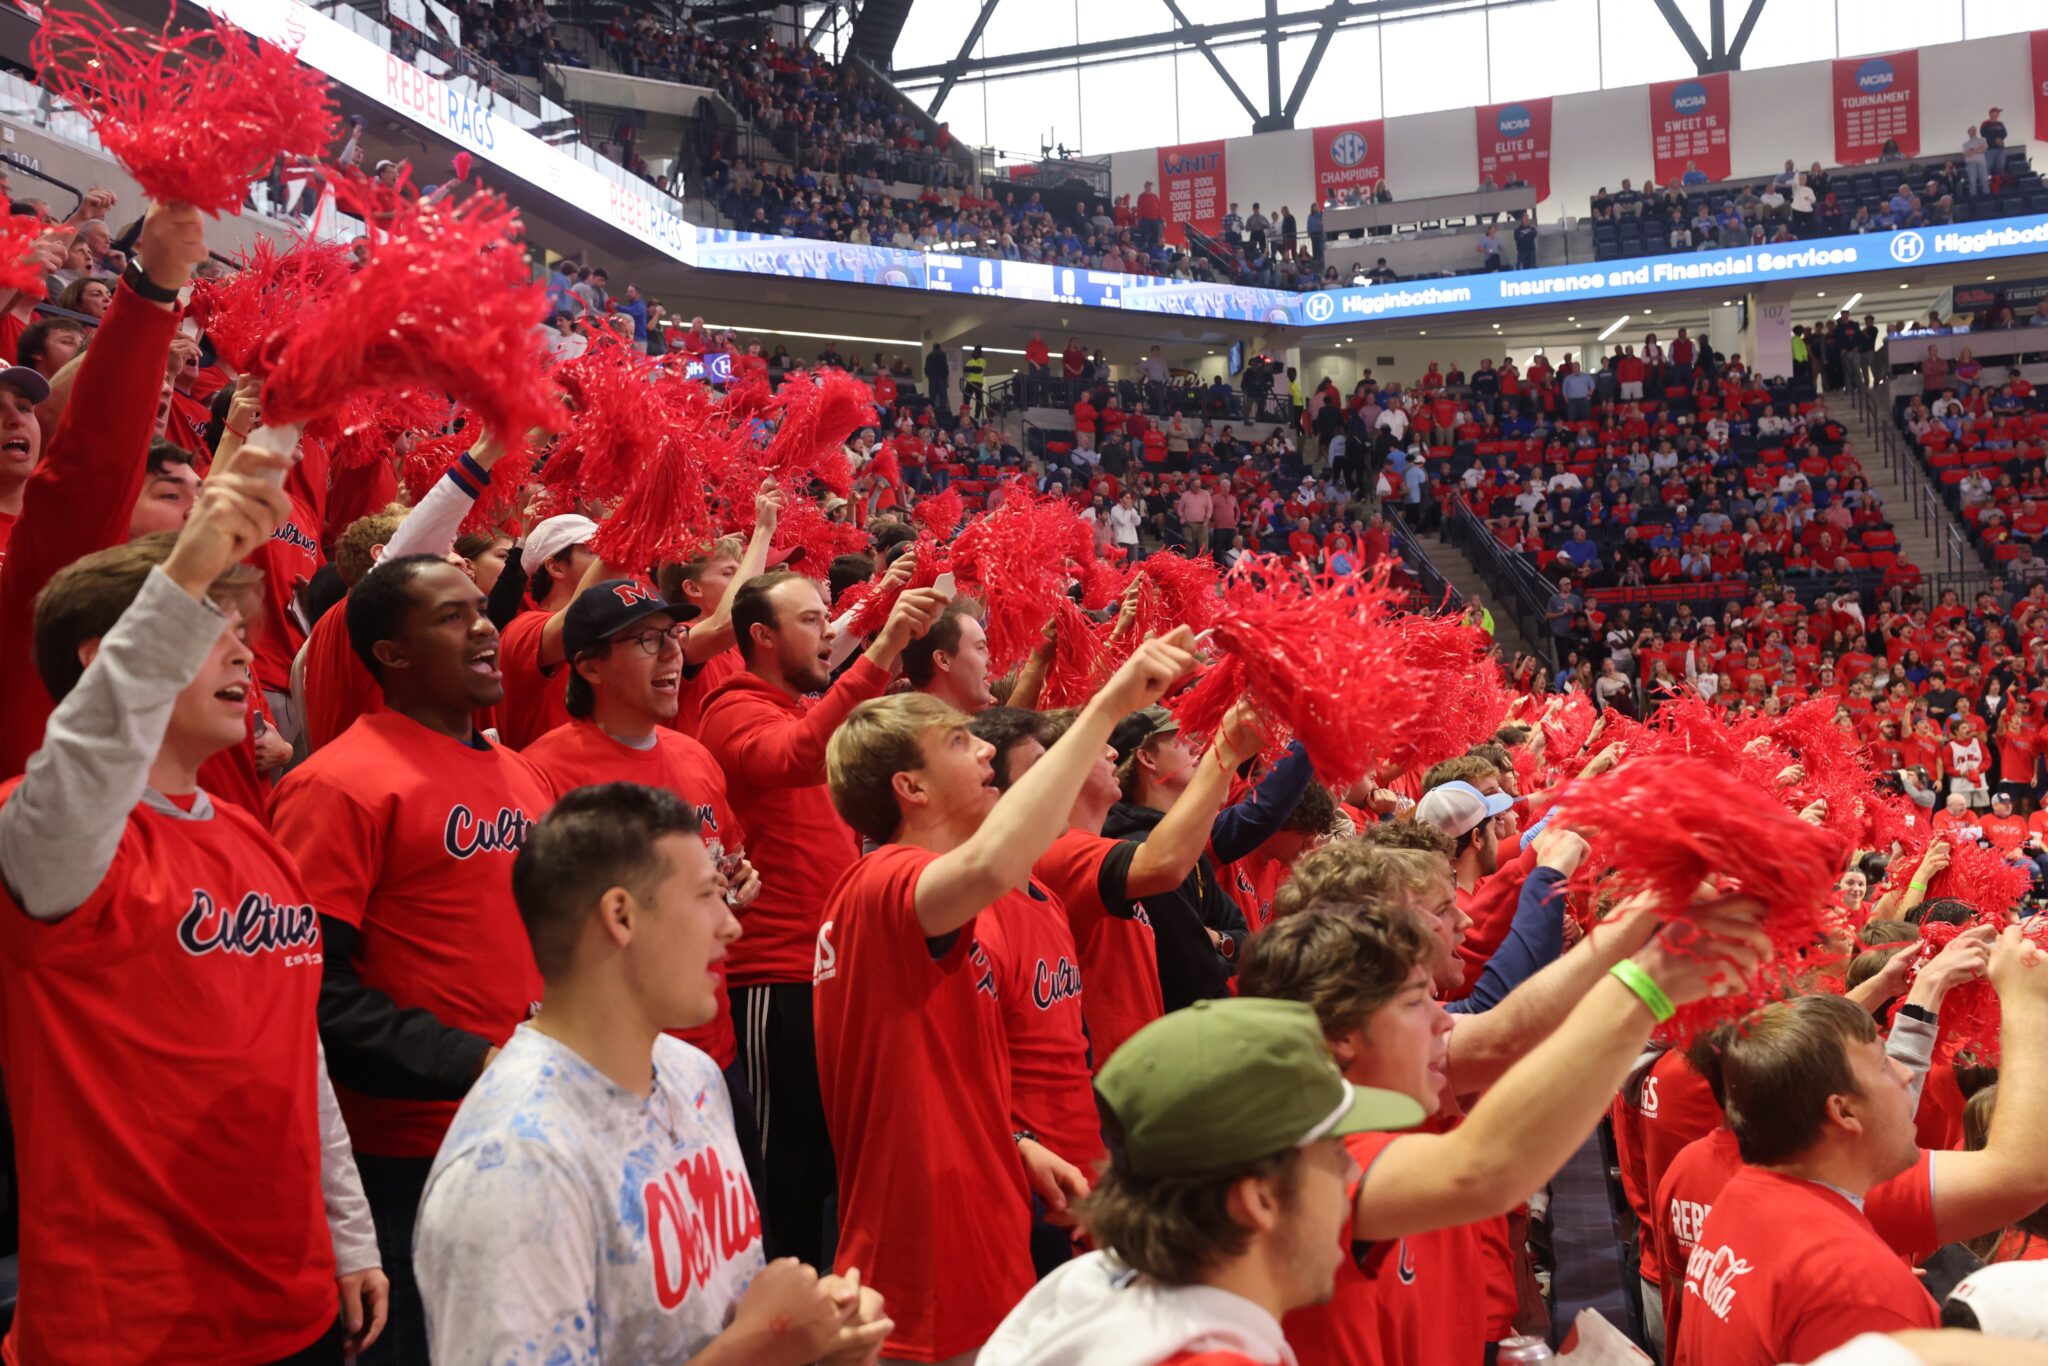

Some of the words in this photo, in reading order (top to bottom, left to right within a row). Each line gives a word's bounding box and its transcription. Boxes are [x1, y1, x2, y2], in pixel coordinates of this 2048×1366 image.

[1860, 73, 1893, 86] NCAA
[1675, 95, 1706, 108] NCAA
[1842, 90, 1910, 108] TOURNAMENT
[1500, 119, 1530, 131] NCAA
[1665, 117, 1702, 133] SWEET
[1706, 115, 1717, 128] 16
[1332, 133, 1365, 165] SEC
[1495, 140, 1523, 153] ELITE
[1164, 152, 1220, 176] WNIT
[1321, 166, 1379, 184] CHAMPIONS
[1935, 223, 2048, 253] Higginbot
[1500, 273, 1604, 299] Insurance
[1609, 266, 1649, 287] and
[1653, 254, 1753, 282] Financial
[1757, 247, 1858, 272] Services
[1342, 286, 1470, 314] Higginbotham
[1763, 304, 1784, 319] 107
[612, 581, 660, 607] M
[444, 803, 536, 860] Cult
